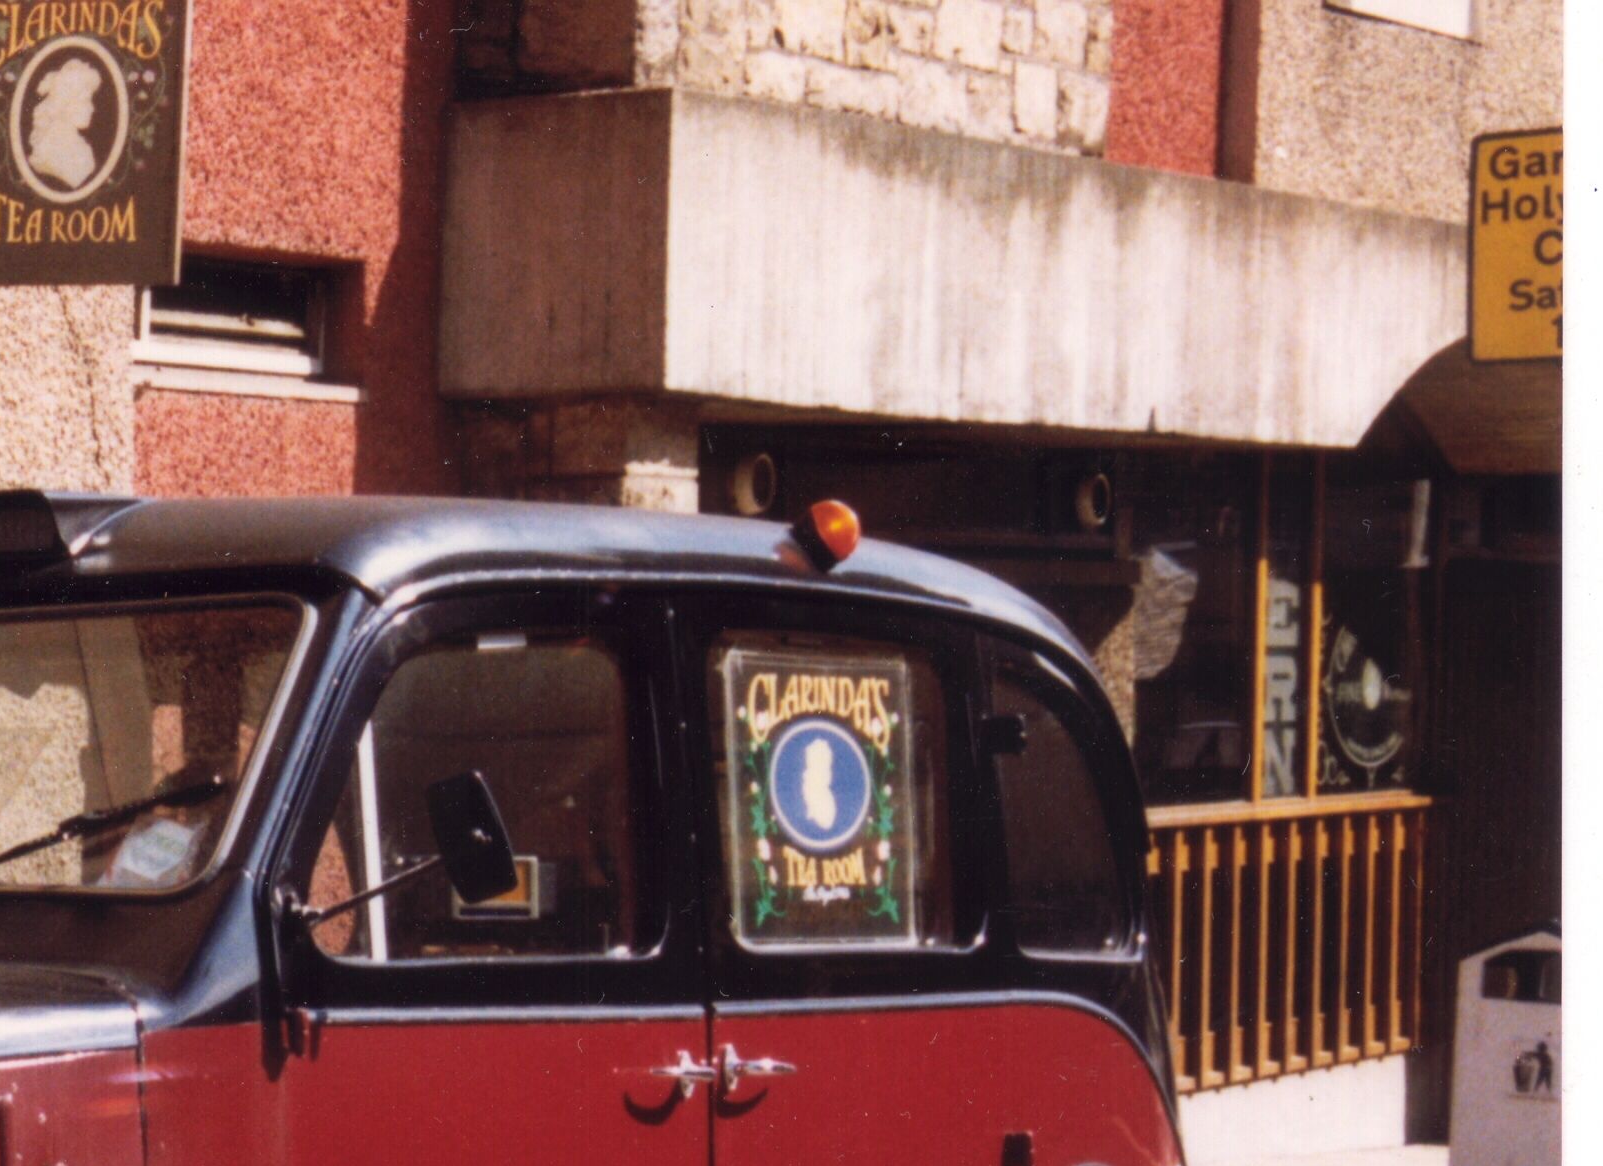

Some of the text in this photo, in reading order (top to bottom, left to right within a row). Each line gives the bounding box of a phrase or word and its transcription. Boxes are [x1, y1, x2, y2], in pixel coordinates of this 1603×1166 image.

[50, 196, 137, 243] ROOM
[782, 845, 867, 887] TEA ROOM
